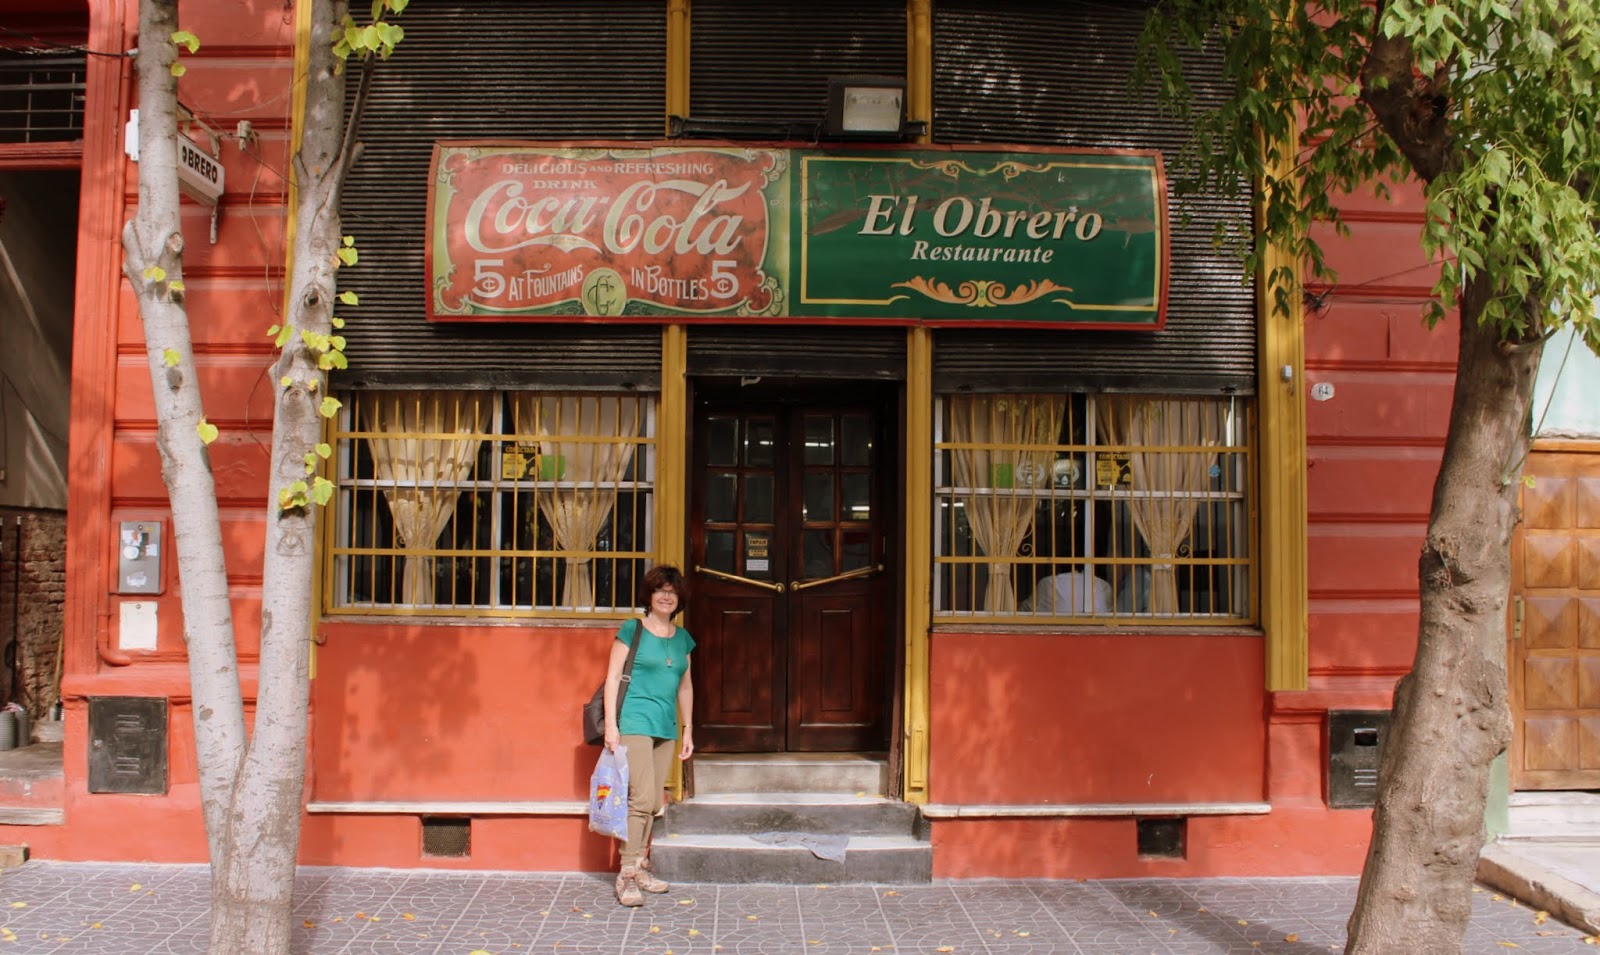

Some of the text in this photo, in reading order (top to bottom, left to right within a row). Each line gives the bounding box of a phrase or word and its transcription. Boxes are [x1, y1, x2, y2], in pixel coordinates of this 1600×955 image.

[502, 162, 714, 175] DELICIOUS AND REFRESHING
[533, 180, 597, 189] DRINK
[857, 194, 1103, 241] El Obrero
[910, 240, 1054, 264] Restaurante
[631, 269, 644, 288] IN
[509, 278, 525, 302] AT
